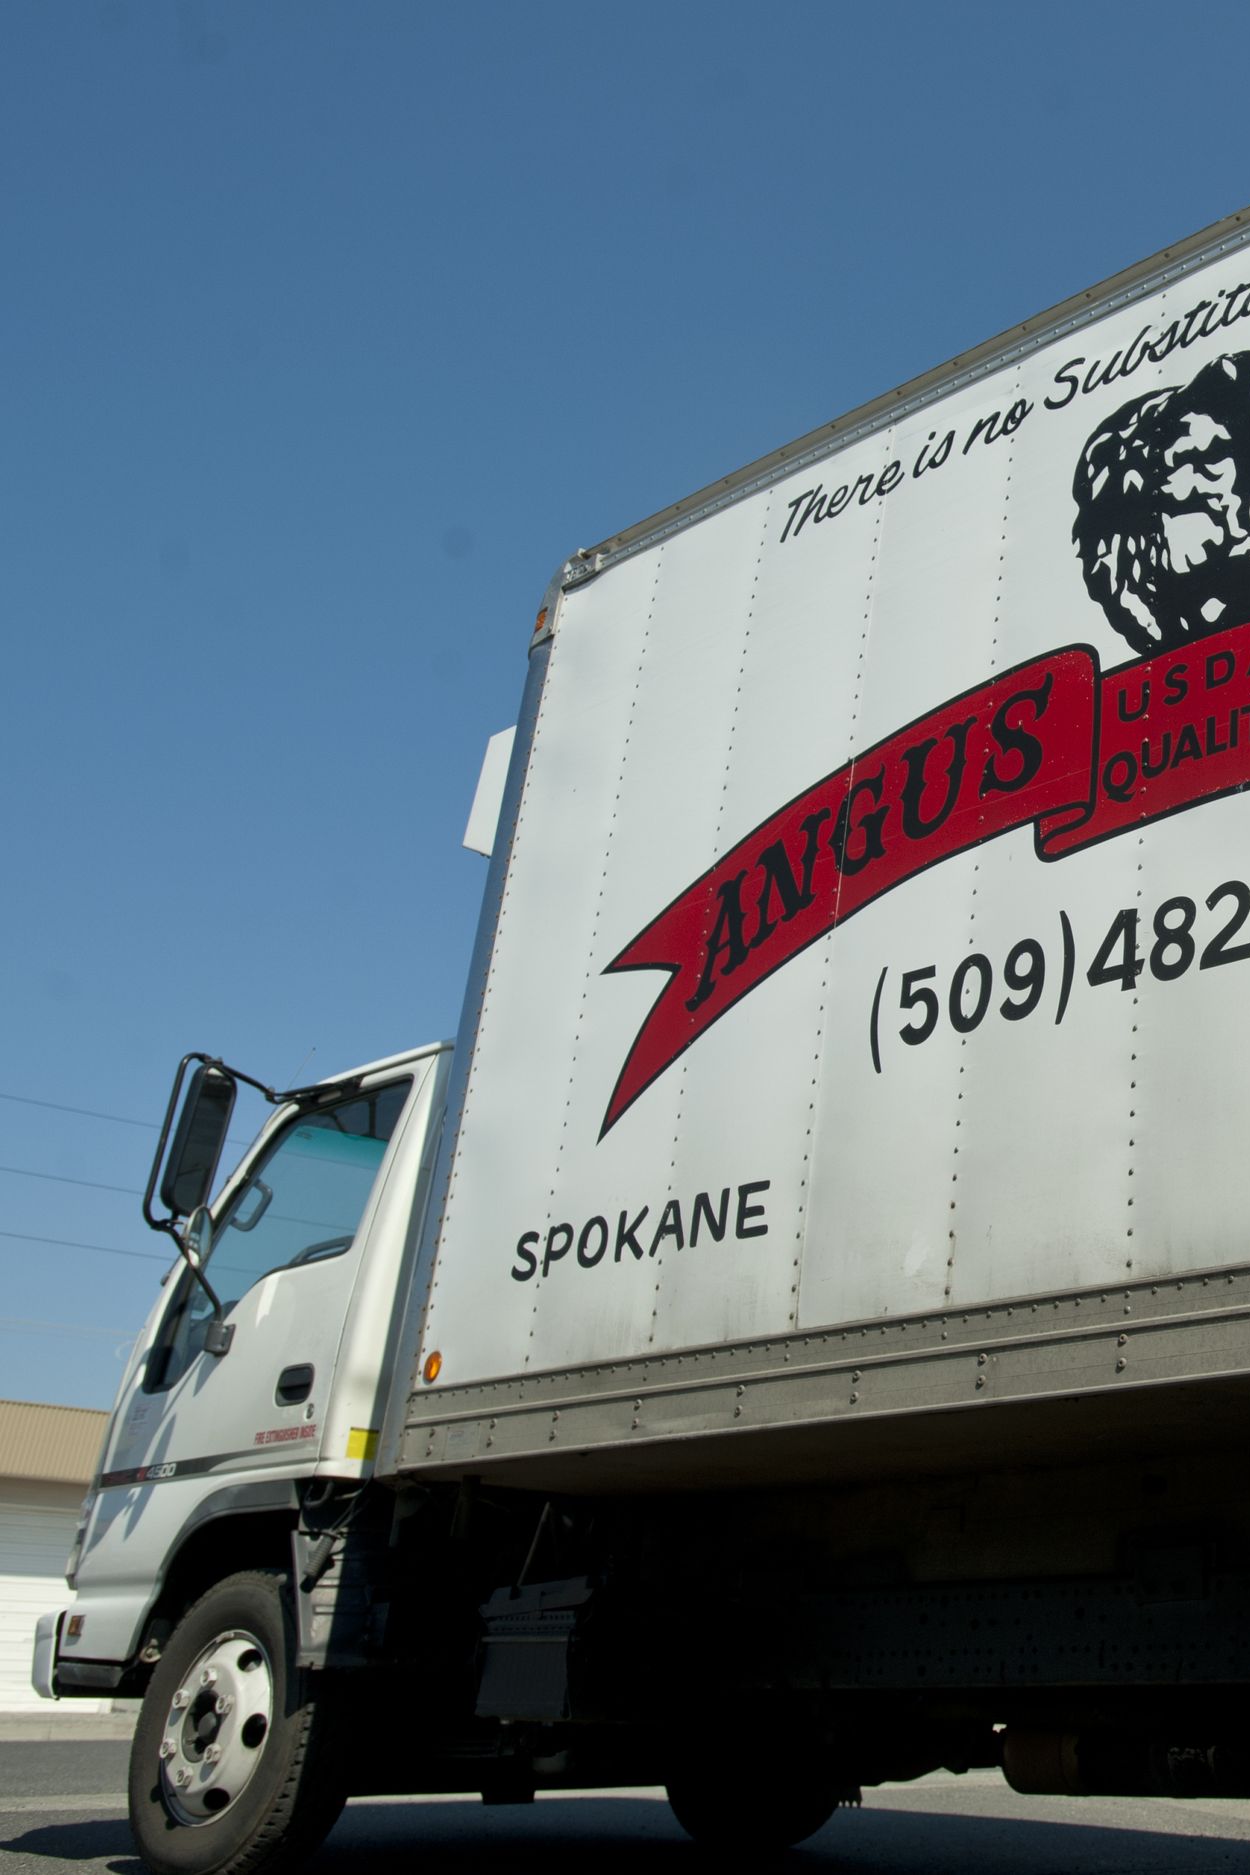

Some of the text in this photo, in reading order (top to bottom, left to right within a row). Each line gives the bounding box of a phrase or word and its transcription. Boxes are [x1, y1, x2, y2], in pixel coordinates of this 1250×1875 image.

[779, 461, 905, 544] There
[912, 428, 956, 477] is
[961, 398, 1033, 457] no
[684, 671, 1054, 1013] ANGUS
[511, 1180, 771, 1282] SPOKANE
